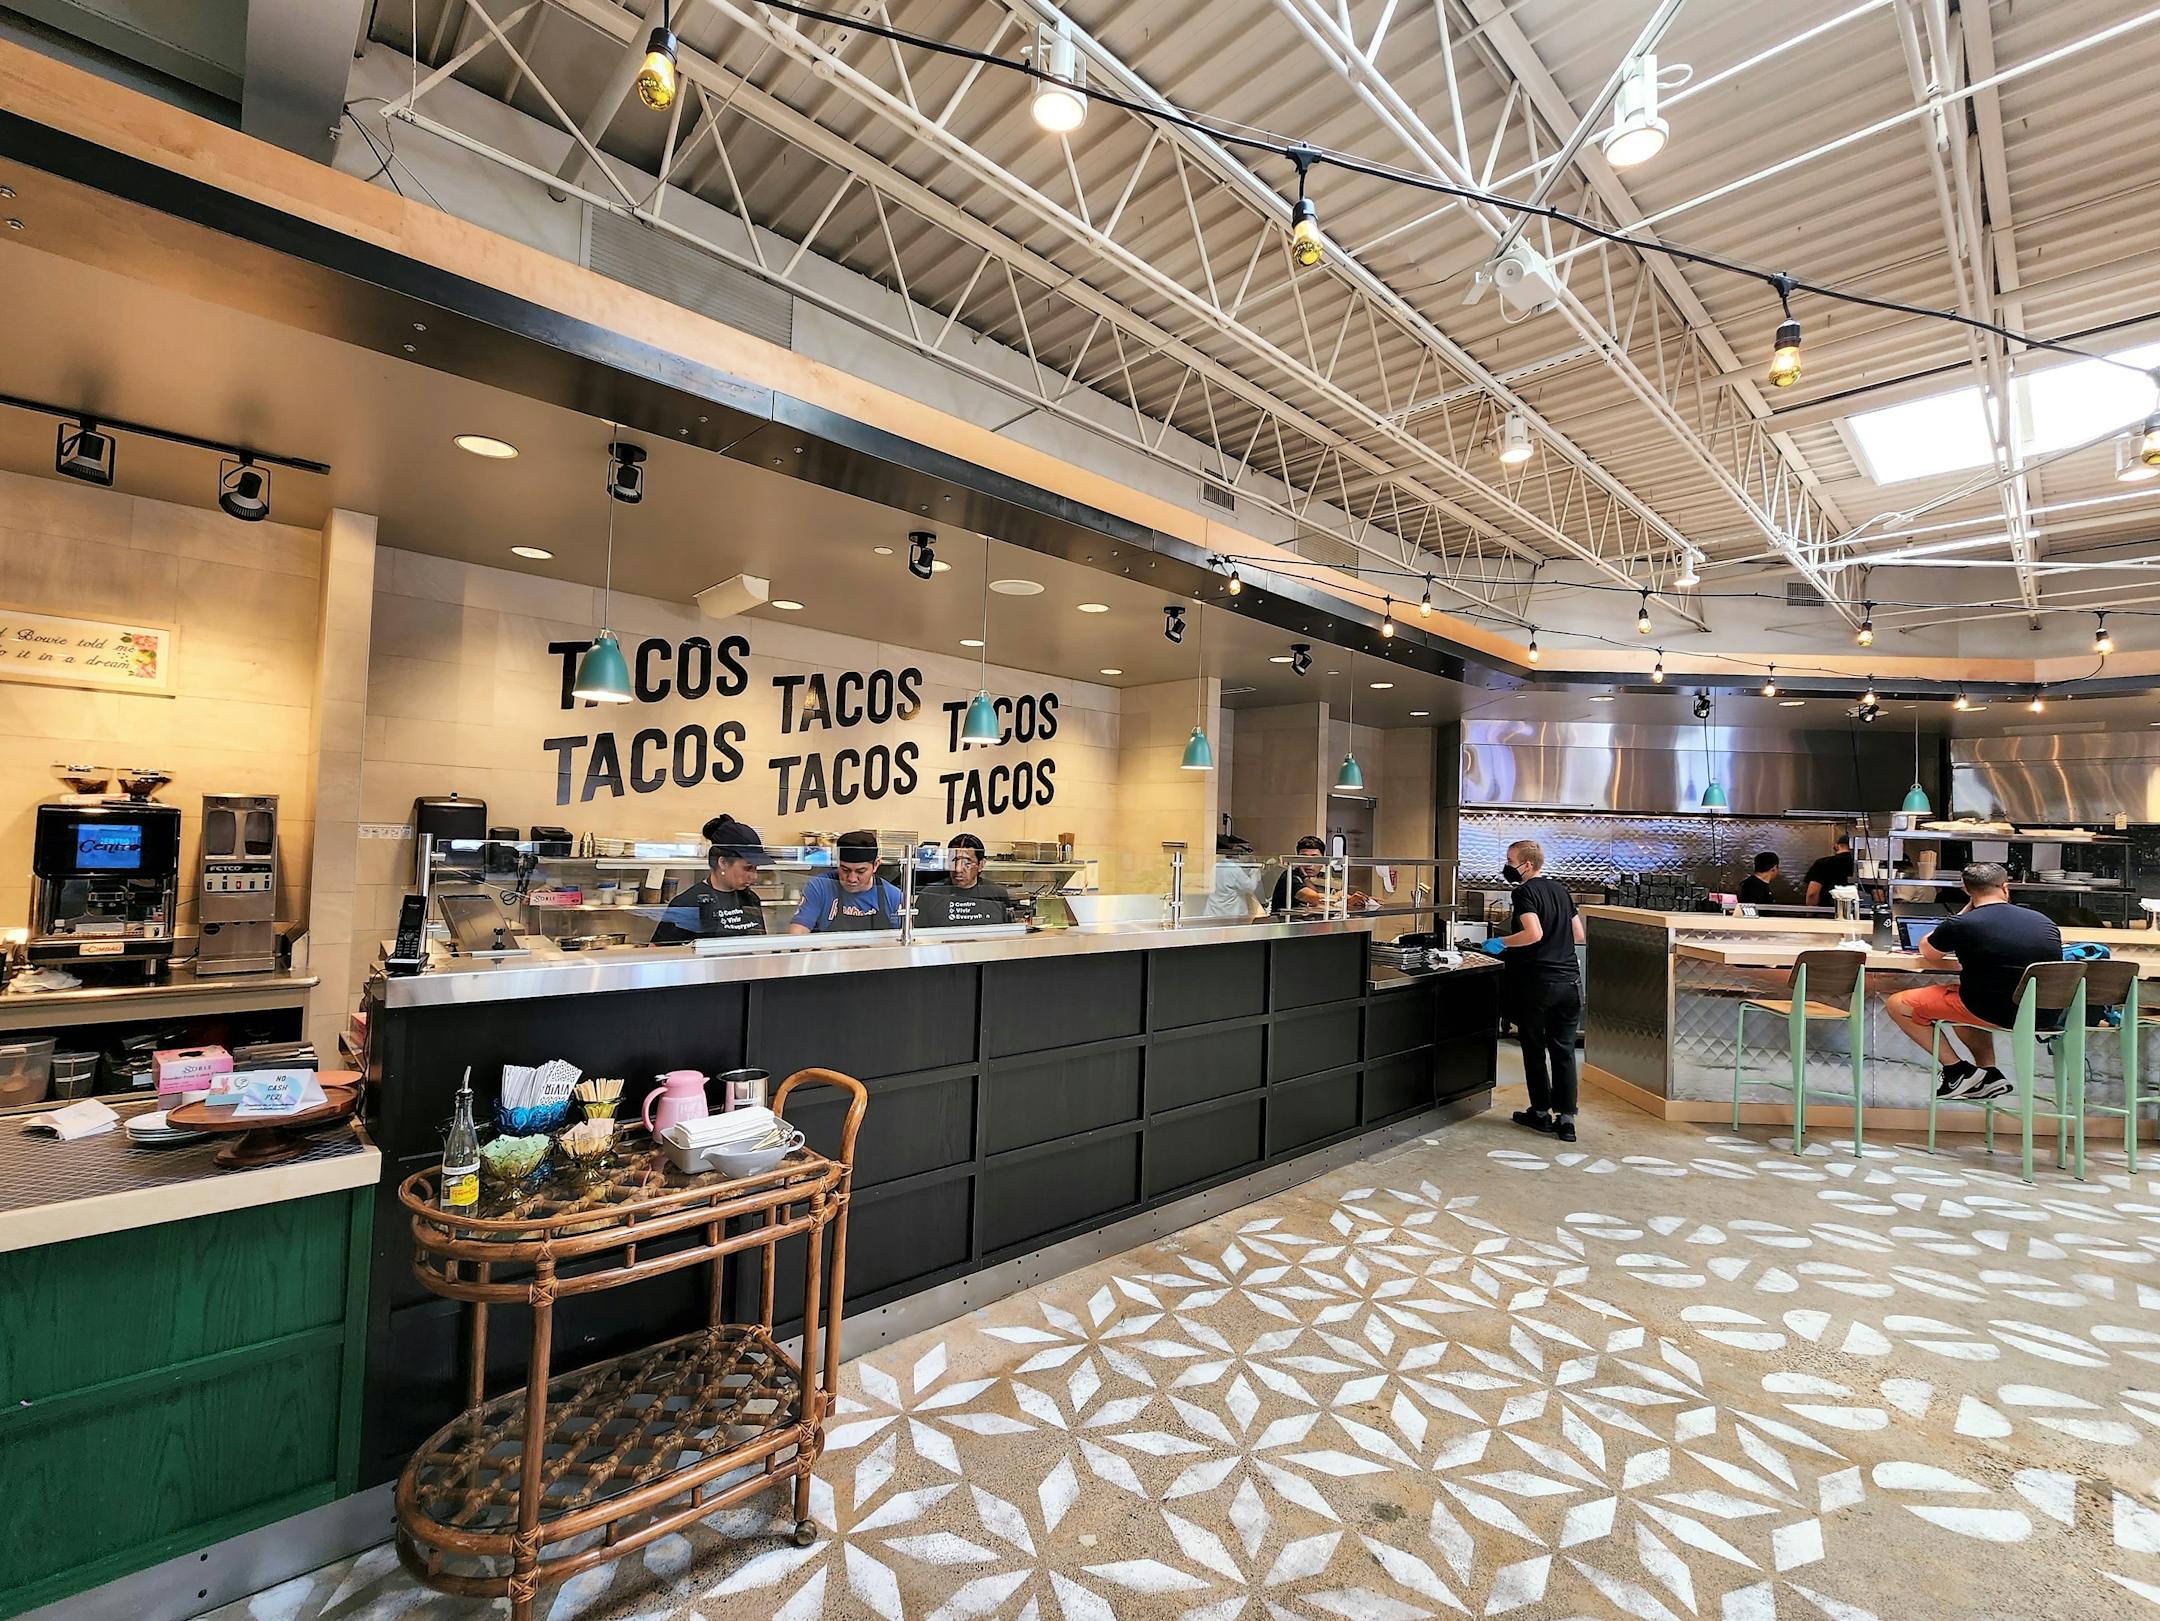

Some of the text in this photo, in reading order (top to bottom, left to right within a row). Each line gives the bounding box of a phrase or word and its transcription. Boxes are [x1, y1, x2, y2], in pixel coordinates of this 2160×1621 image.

[16, 649, 31, 659] it
[38, 651, 53, 661] in
[64, 656, 76, 664] a
[85, 655, 130, 669] dream
[17, 628, 67, 645] Bowie
[77, 639, 108, 650] told
[113, 644, 135, 653] me
[548, 635, 1059, 753] TCOS TACOS TCOS
[543, 720, 1056, 825] TACOS TACOS TACOS
